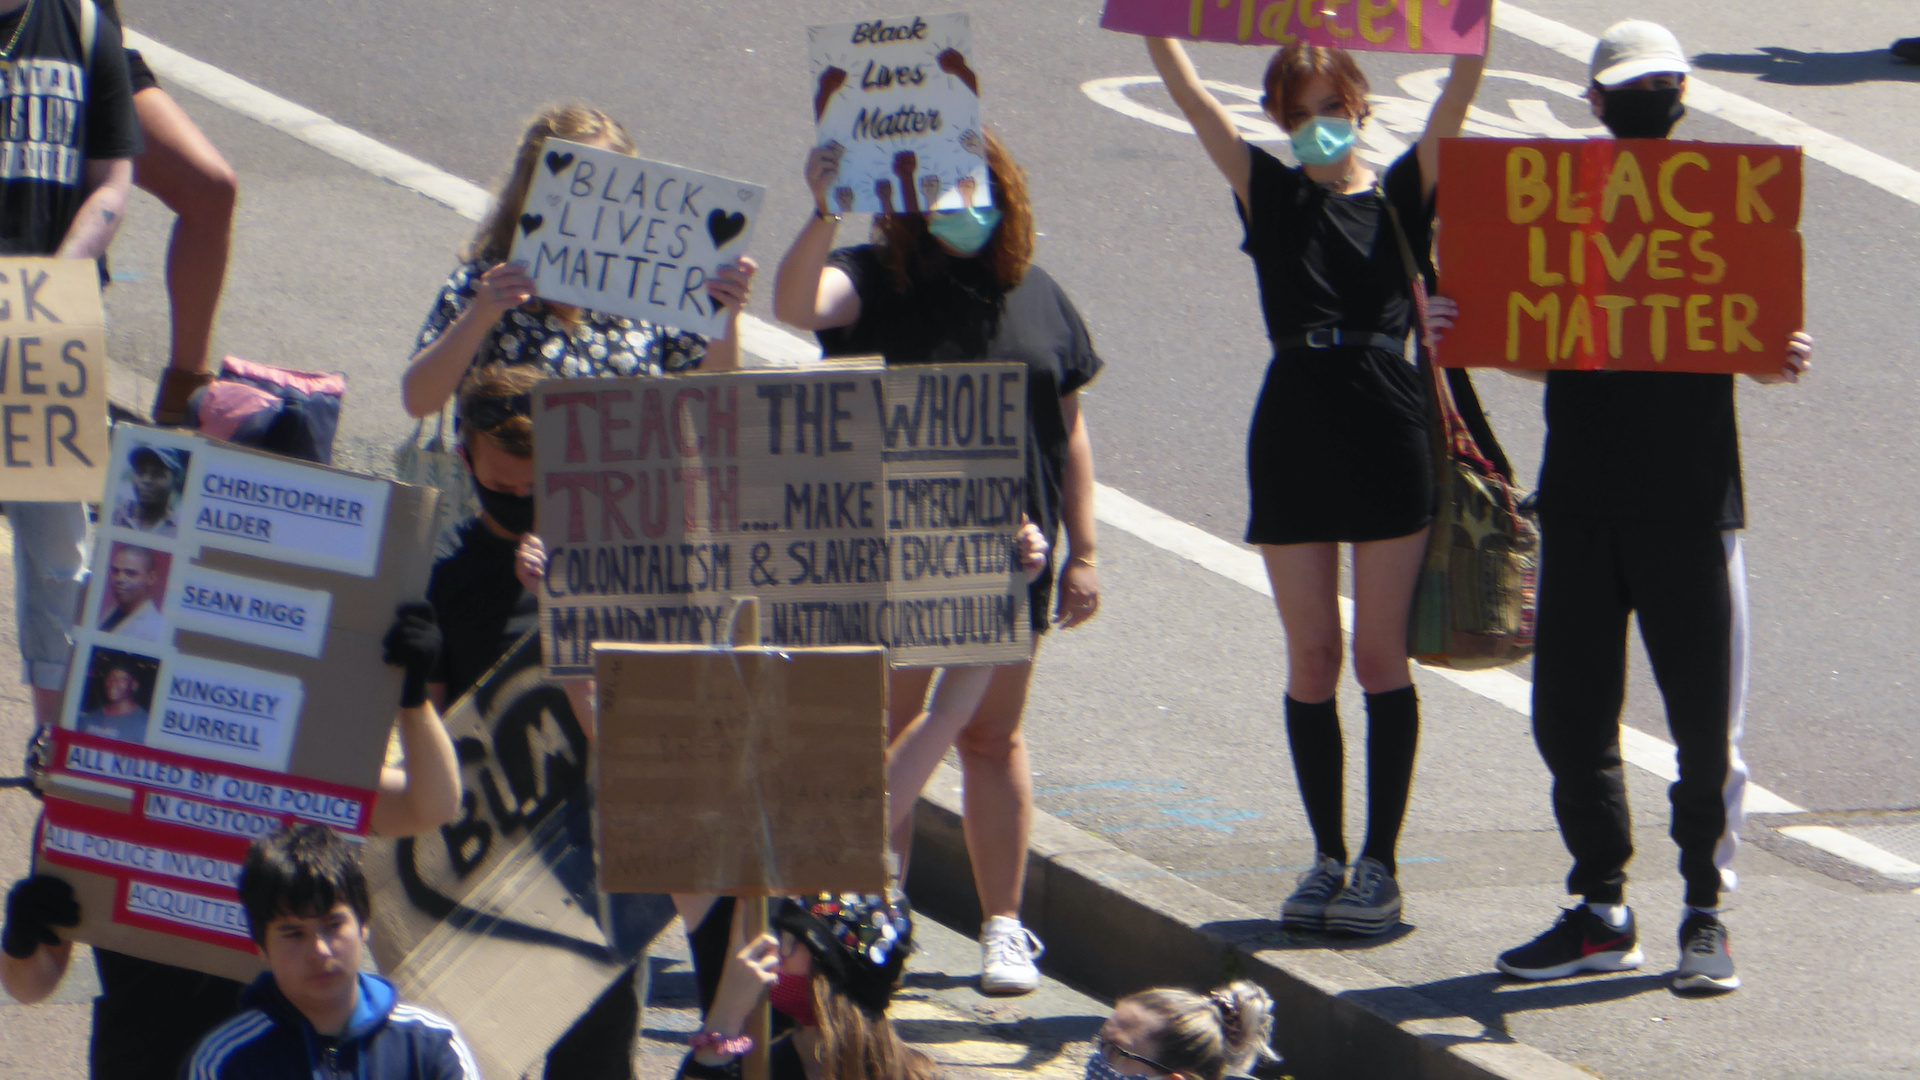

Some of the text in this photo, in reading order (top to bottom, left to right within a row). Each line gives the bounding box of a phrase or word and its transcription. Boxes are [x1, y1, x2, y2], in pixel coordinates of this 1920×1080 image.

[851, 16, 927, 44] Black
[861, 59, 925, 89] Lives
[852, 104, 942, 141] Matter
[569, 160, 702, 219] BLACK
[1505, 146, 1782, 228] BLACK
[558, 202, 692, 259] LIVES
[1528, 227, 1727, 286] LIVES
[534, 241, 714, 316] MATTER
[1505, 291, 1764, 363] MATTER
[544, 372, 1020, 464] TEACH THE WHOLE
[196, 507, 272, 537] ALDER
[202, 473, 365, 521] CHRISTOPHER
[785, 481, 874, 530] MAKE
[888, 477, 1026, 529] IMPERIALISM
[544, 542, 731, 598] COLONIALISM
[748, 541, 779, 587] &
[787, 537, 892, 586] SLAVERY
[182, 584, 307, 626] SEAN RIGG
[552, 605, 723, 665] MANDATORY
[876, 595, 1016, 648] CURRICULUM
[170, 675, 280, 716] KINGSLEY
[162, 712, 260, 748] BURRELL
[68, 747, 358, 820] ALL KILLED BY OUR POLICE
[146, 793, 282, 835] IN CUSTODY
[46, 826, 78, 852] ALL
[83, 835, 156, 868] POLICE
